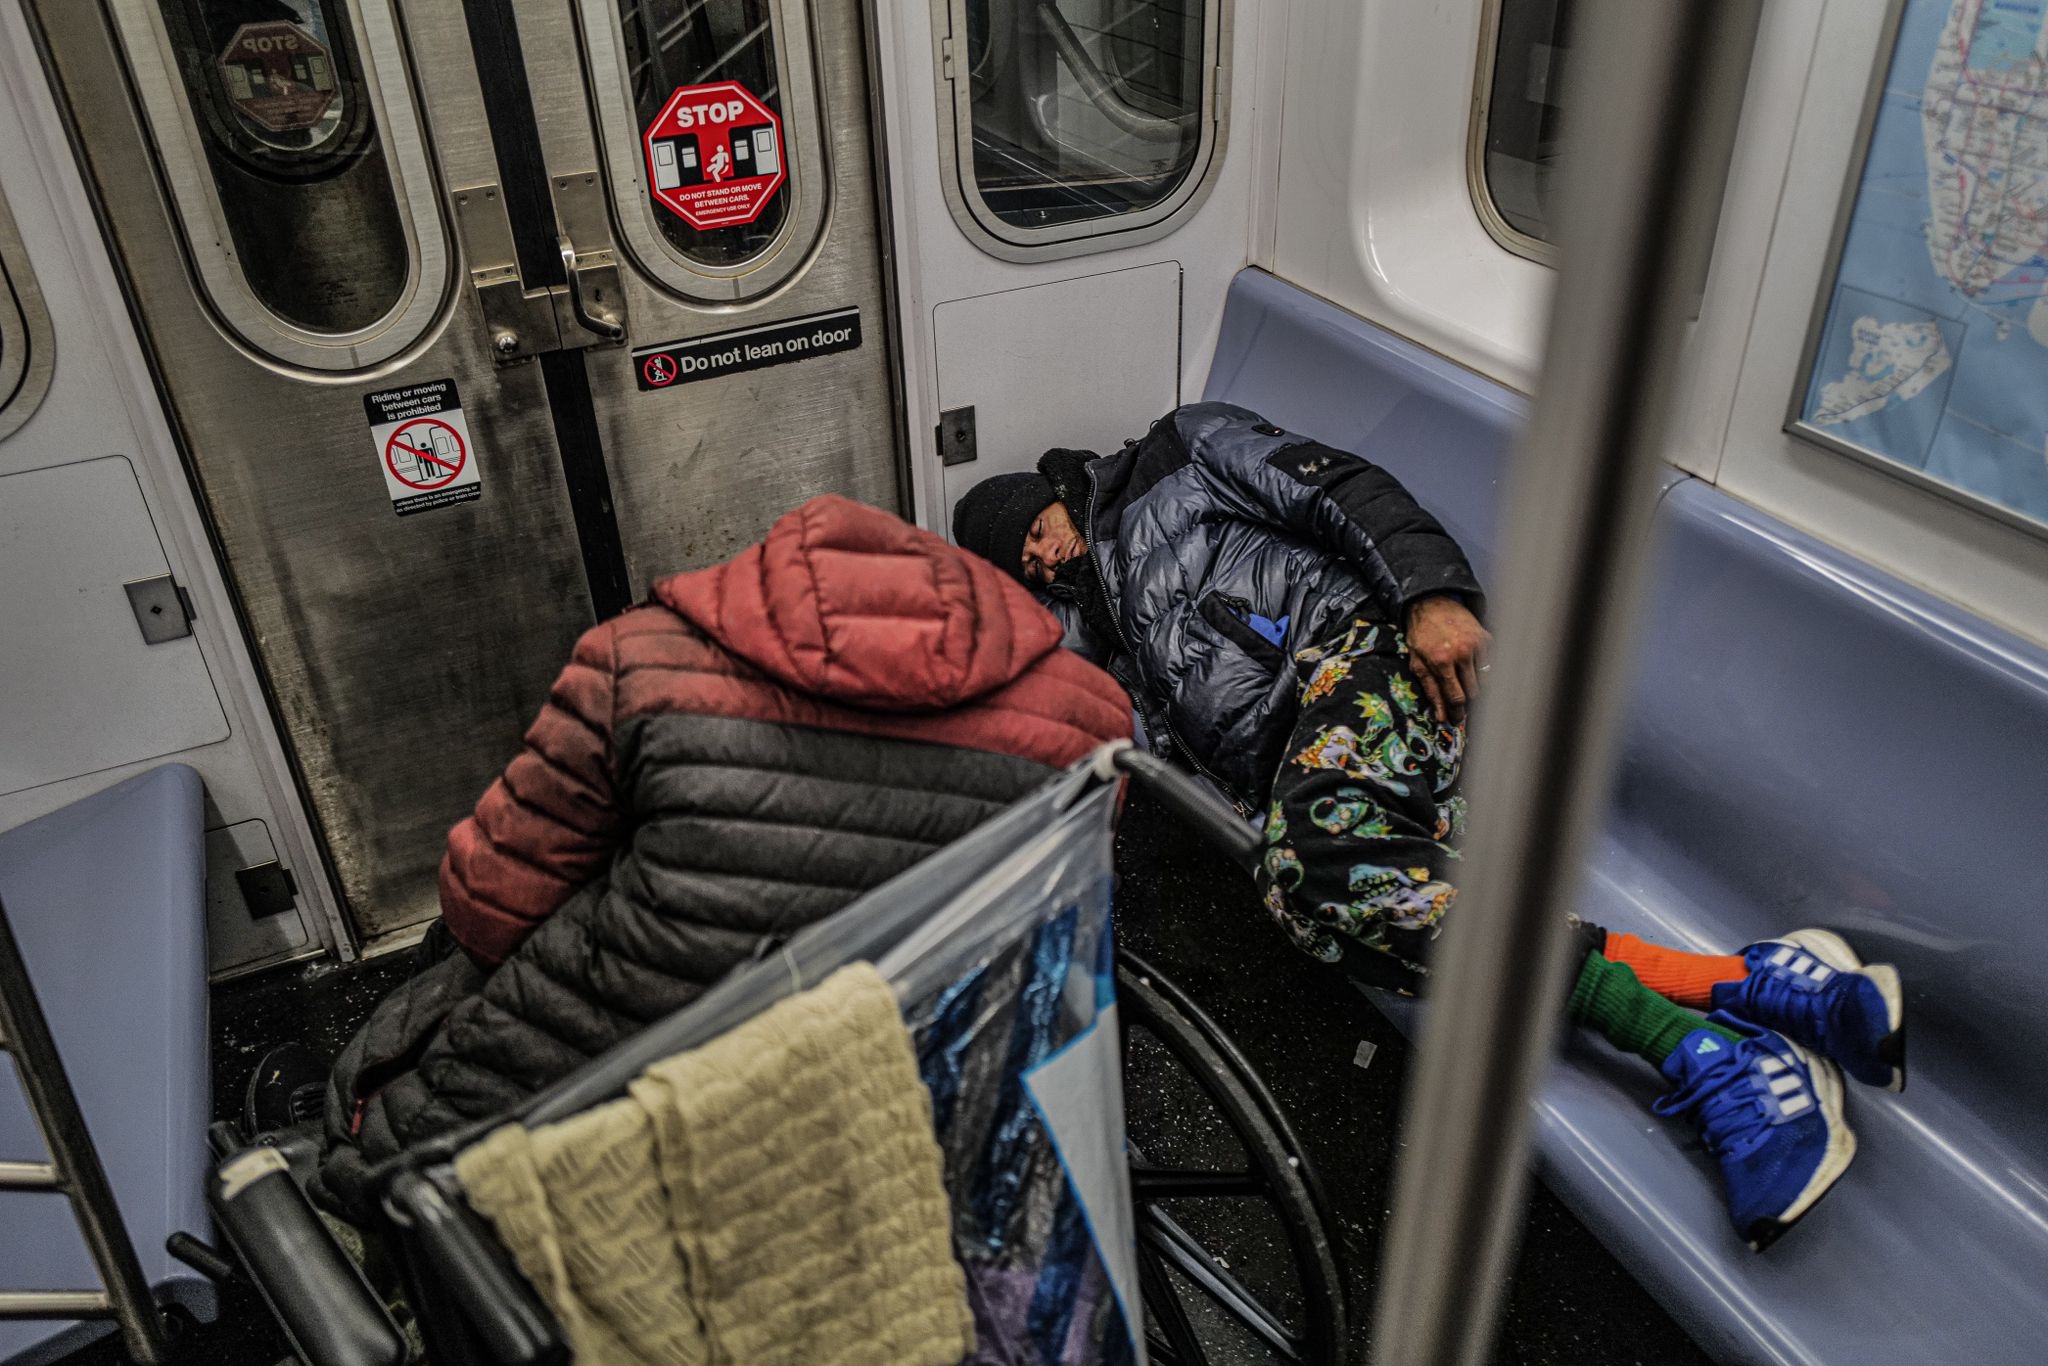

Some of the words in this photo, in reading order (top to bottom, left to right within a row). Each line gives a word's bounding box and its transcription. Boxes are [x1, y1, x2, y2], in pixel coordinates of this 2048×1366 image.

[677, 101, 744, 128] STOP
[691, 191, 706, 199] NOT
[706, 188, 730, 197] STAND
[741, 183, 762, 192] MOVE
[694, 197, 728, 208] BETWEEN
[695, 207, 726, 216] EMERGENCY
[680, 356, 709, 374] Do
[710, 347, 742, 366] not
[745, 341, 784, 361] lean
[785, 336, 809, 352] on
[811, 328, 852, 347] door
[371, 392, 401, 404] Riding
[413, 383, 447, 395] moving
[381, 398, 420, 412] between
[422, 394, 442, 403] cars
[386, 412, 396, 420] is
[397, 403, 442, 419] prohibited
[403, 503, 425, 511] directed
